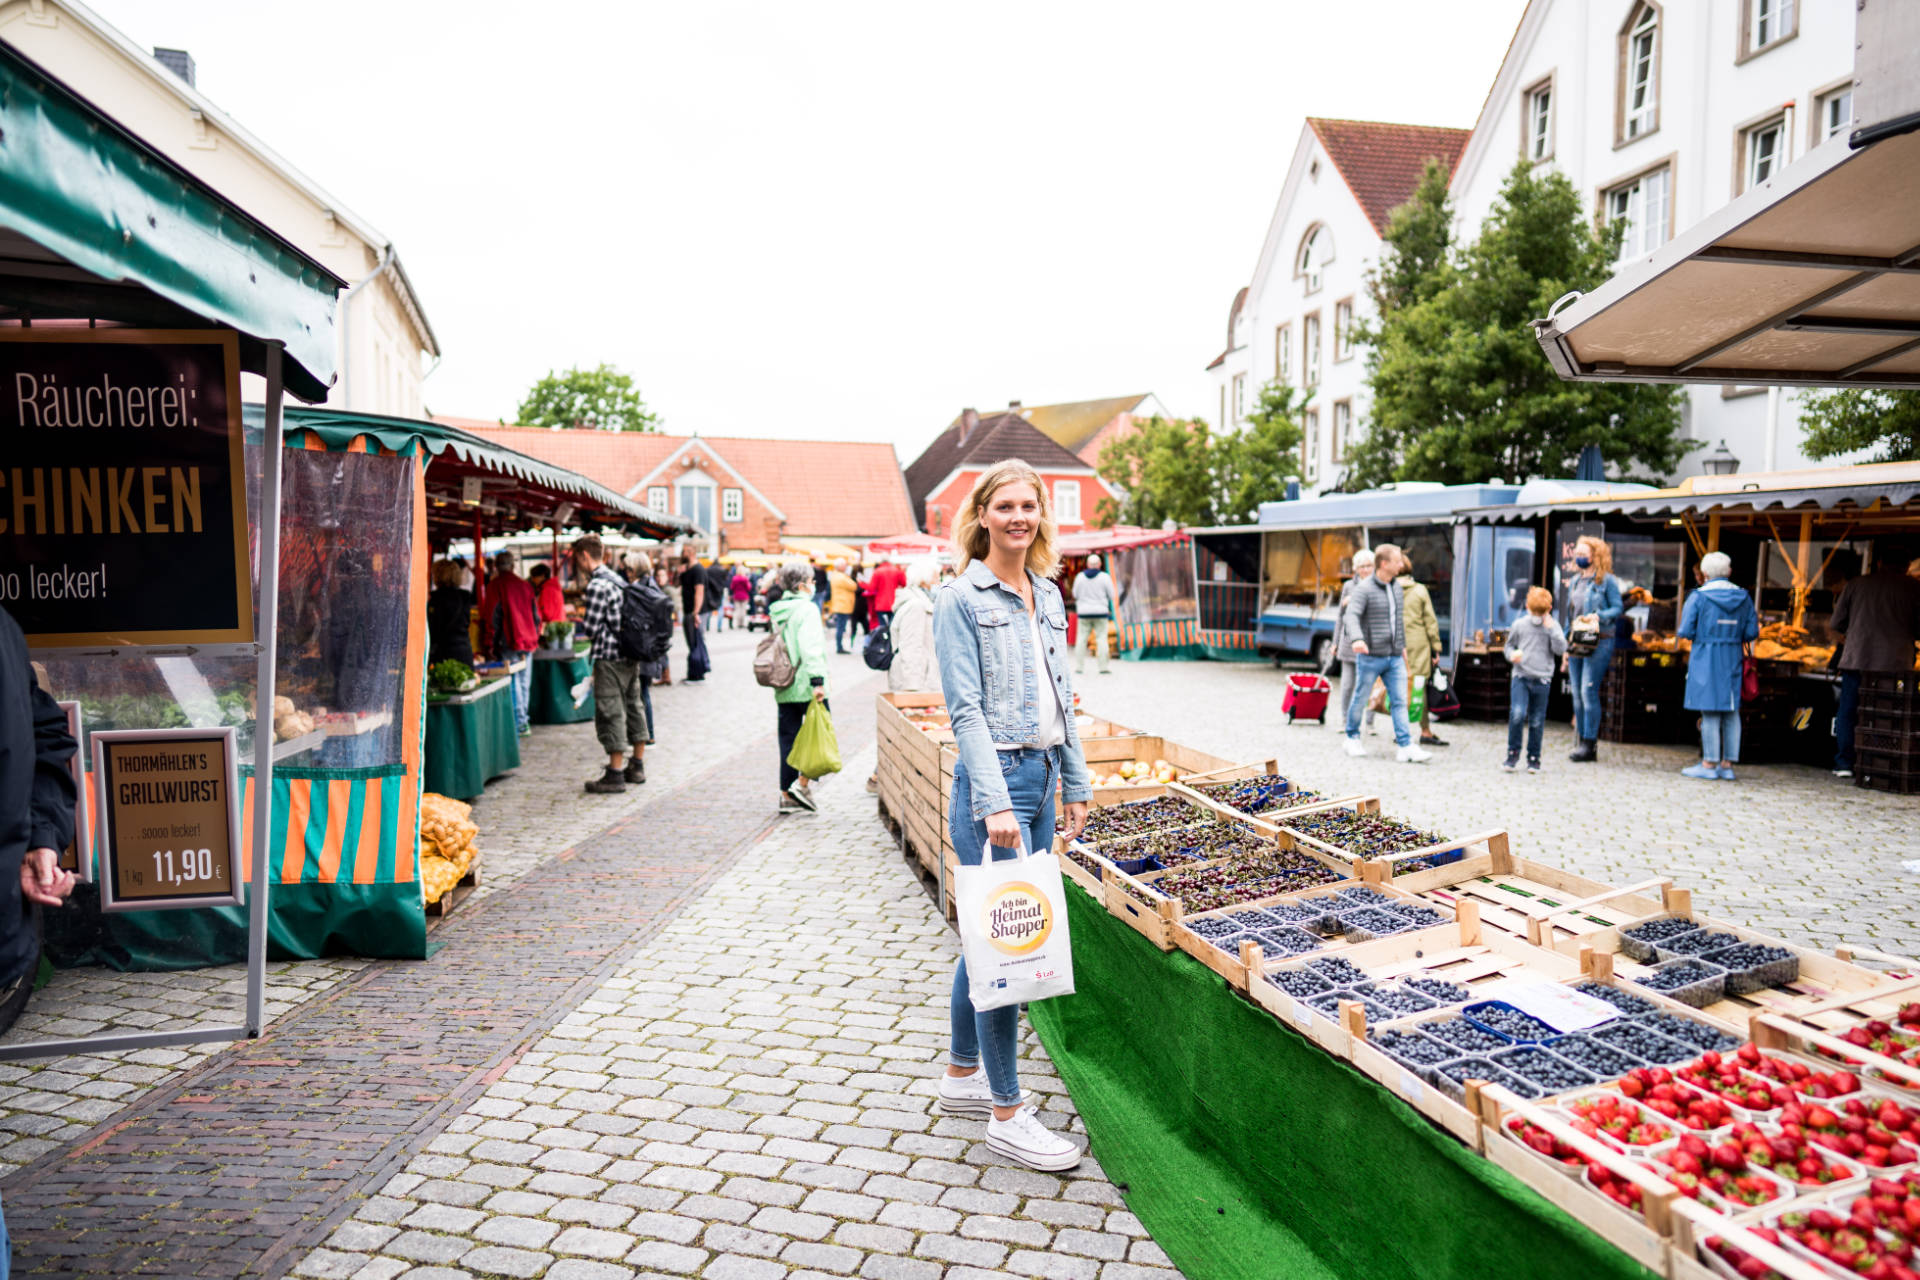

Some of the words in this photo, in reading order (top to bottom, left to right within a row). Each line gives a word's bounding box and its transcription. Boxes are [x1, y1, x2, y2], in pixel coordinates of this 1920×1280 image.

[16, 372, 199, 427] Räucherei:
[0, 466, 203, 535] HINKEN
[30, 562, 107, 600] lecker!
[117, 752, 208, 773] THORMÄHLEN'S
[120, 780, 218, 805] GRILLWURST
[171, 823, 200, 838] lecker!
[153, 848, 213, 886] 11,90
[1001, 900, 1013, 909] Ich
[1015, 898, 1027, 906] bin
[991, 918, 1047, 938] Shopper
